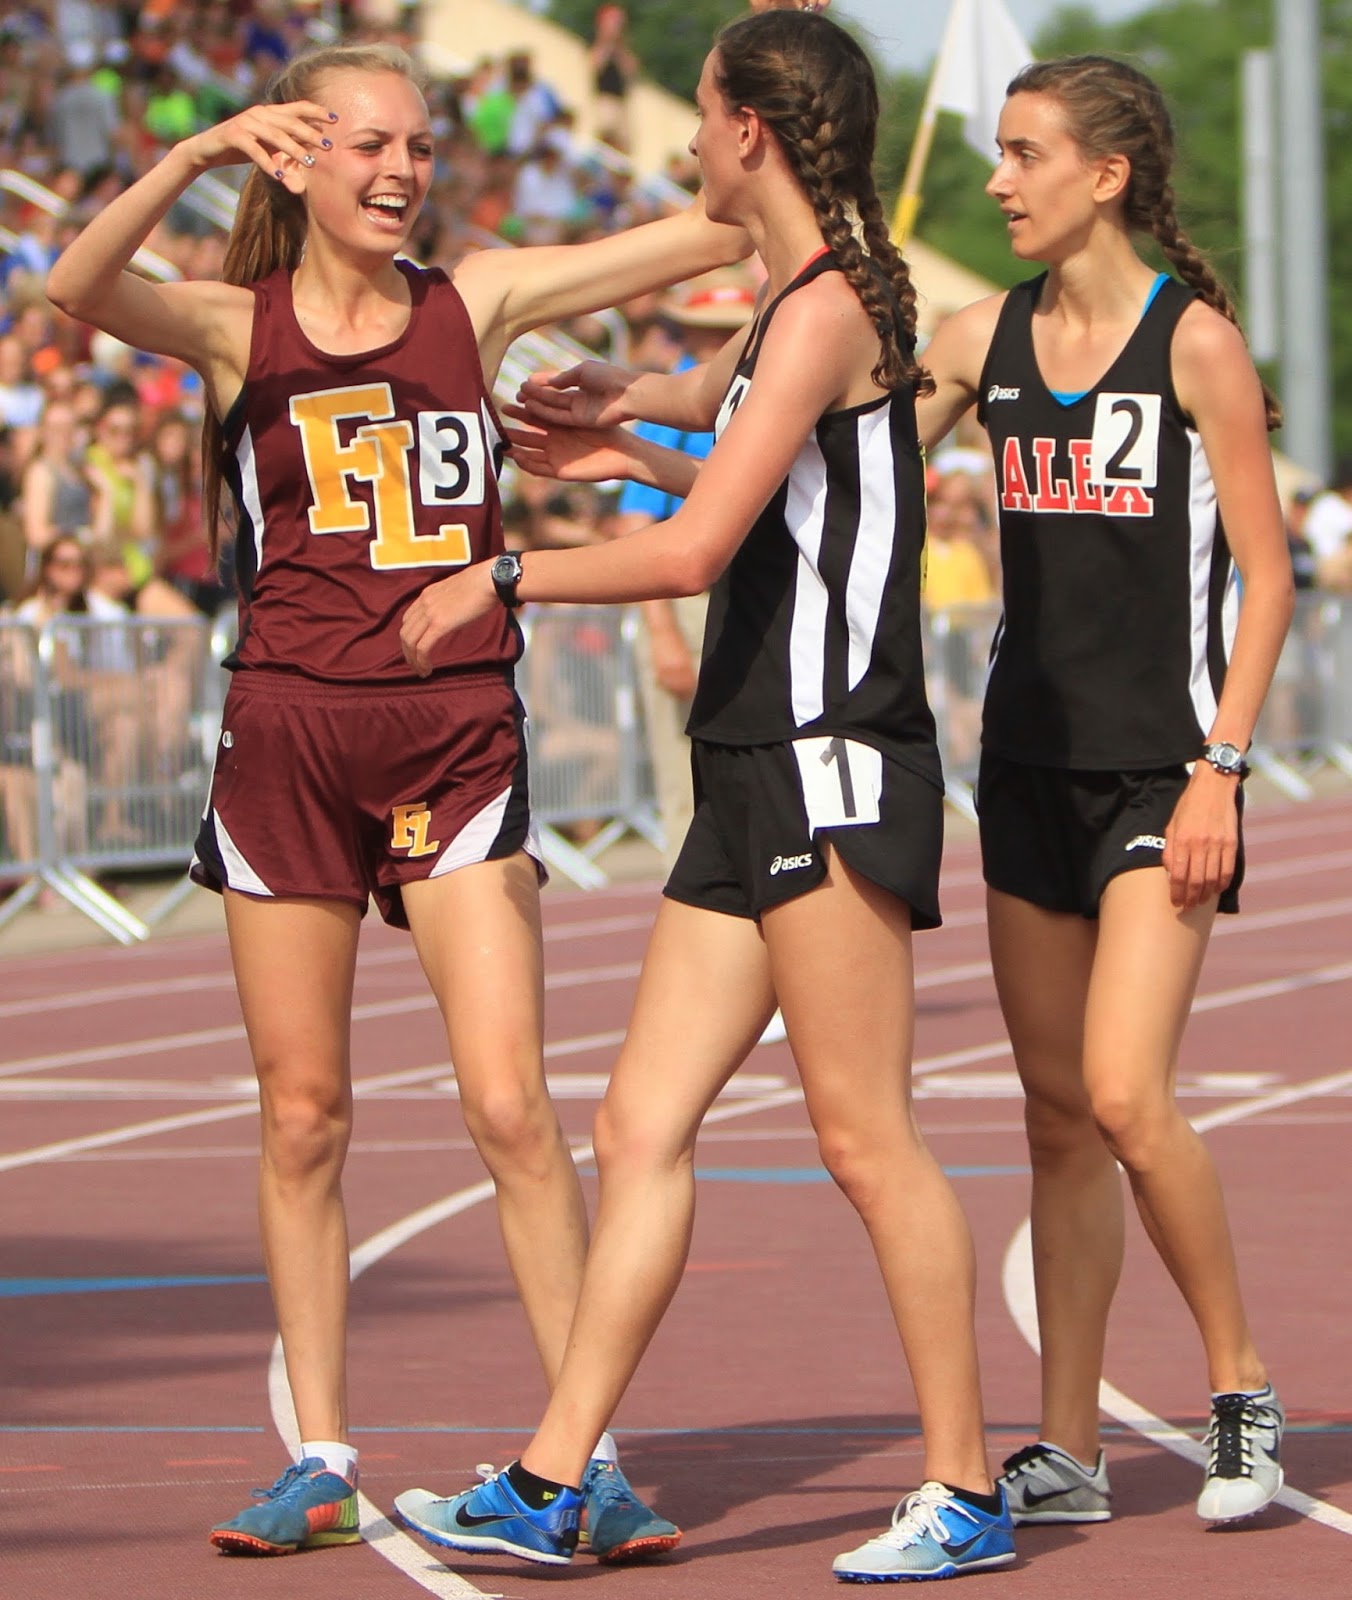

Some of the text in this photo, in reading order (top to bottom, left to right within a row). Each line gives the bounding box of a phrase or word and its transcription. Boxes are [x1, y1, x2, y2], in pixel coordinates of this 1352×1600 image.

[289, 382, 471, 570] FL
[434, 416, 470, 500] 3
[1105, 398, 1143, 480] 2
[819, 736, 857, 818] 1
[391, 802, 440, 857] FL
[781, 853, 813, 871] asics
